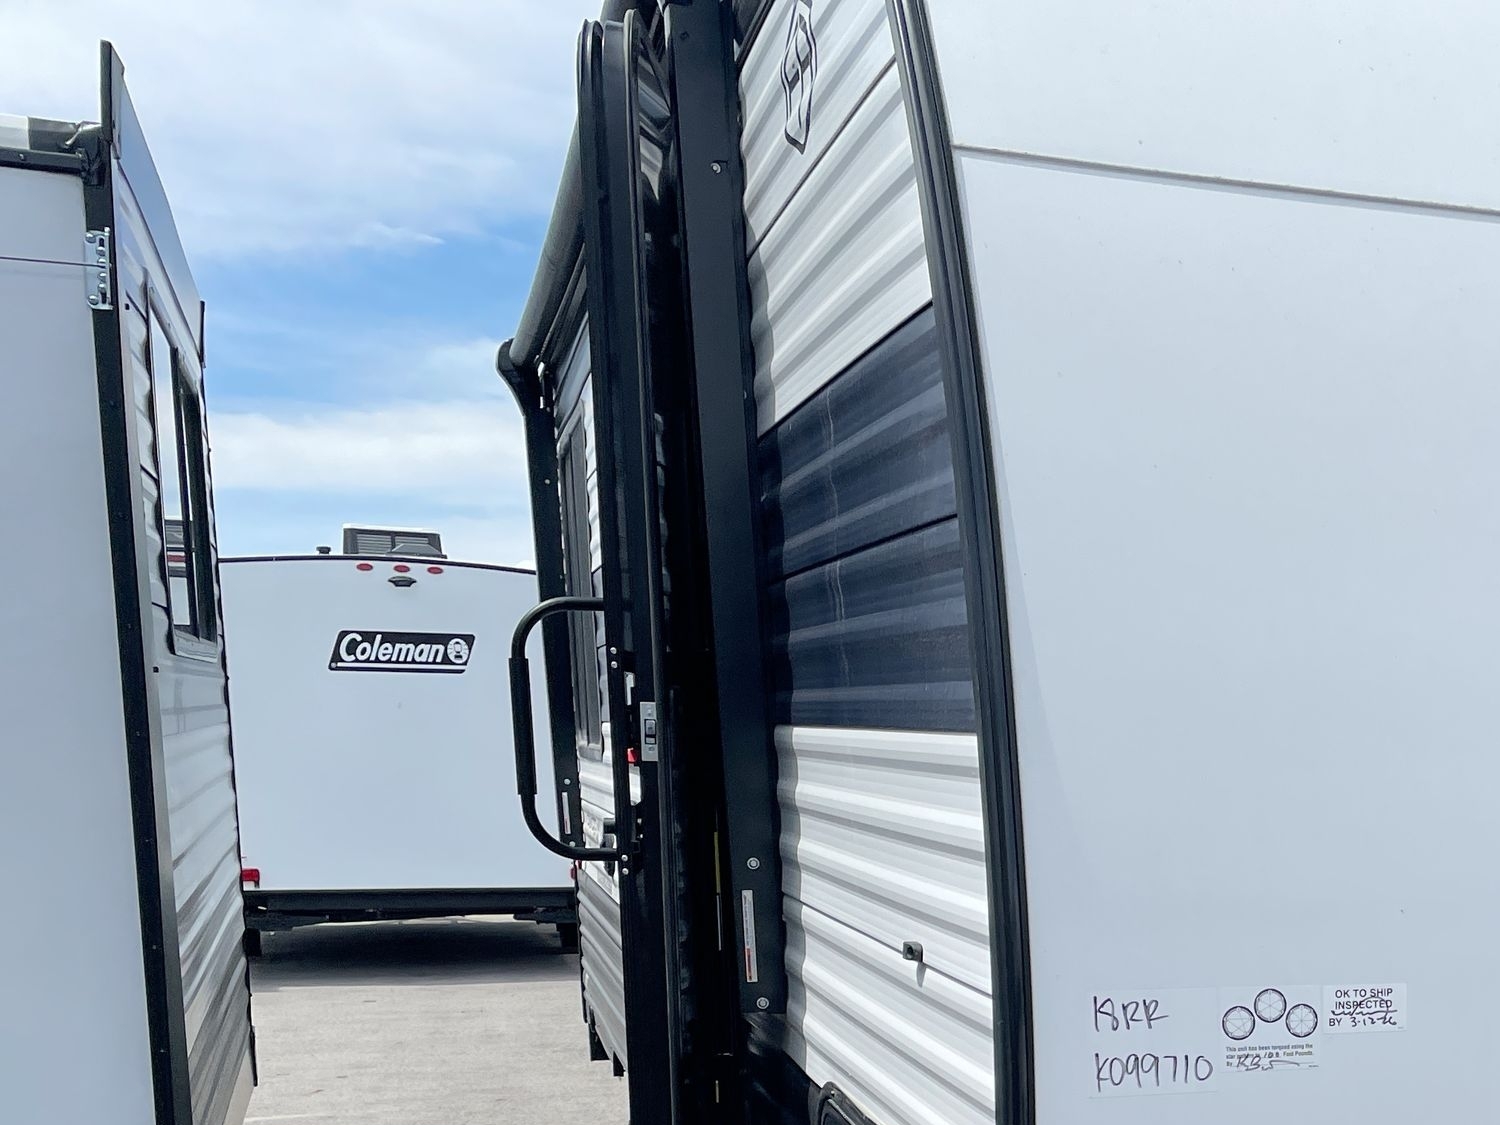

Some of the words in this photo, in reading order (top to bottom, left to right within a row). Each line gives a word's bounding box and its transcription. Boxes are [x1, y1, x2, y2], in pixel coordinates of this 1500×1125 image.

[340, 632, 445, 662] Coleman
[1335, 989, 1351, 998] OK
[1353, 989, 1367, 998] TO
[1370, 988, 1393, 998] SHIP
[1335, 1000, 1393, 1010] INSPECTED
[1329, 1018, 1342, 1027] BY
[1095, 1052, 1214, 1093] K099710
